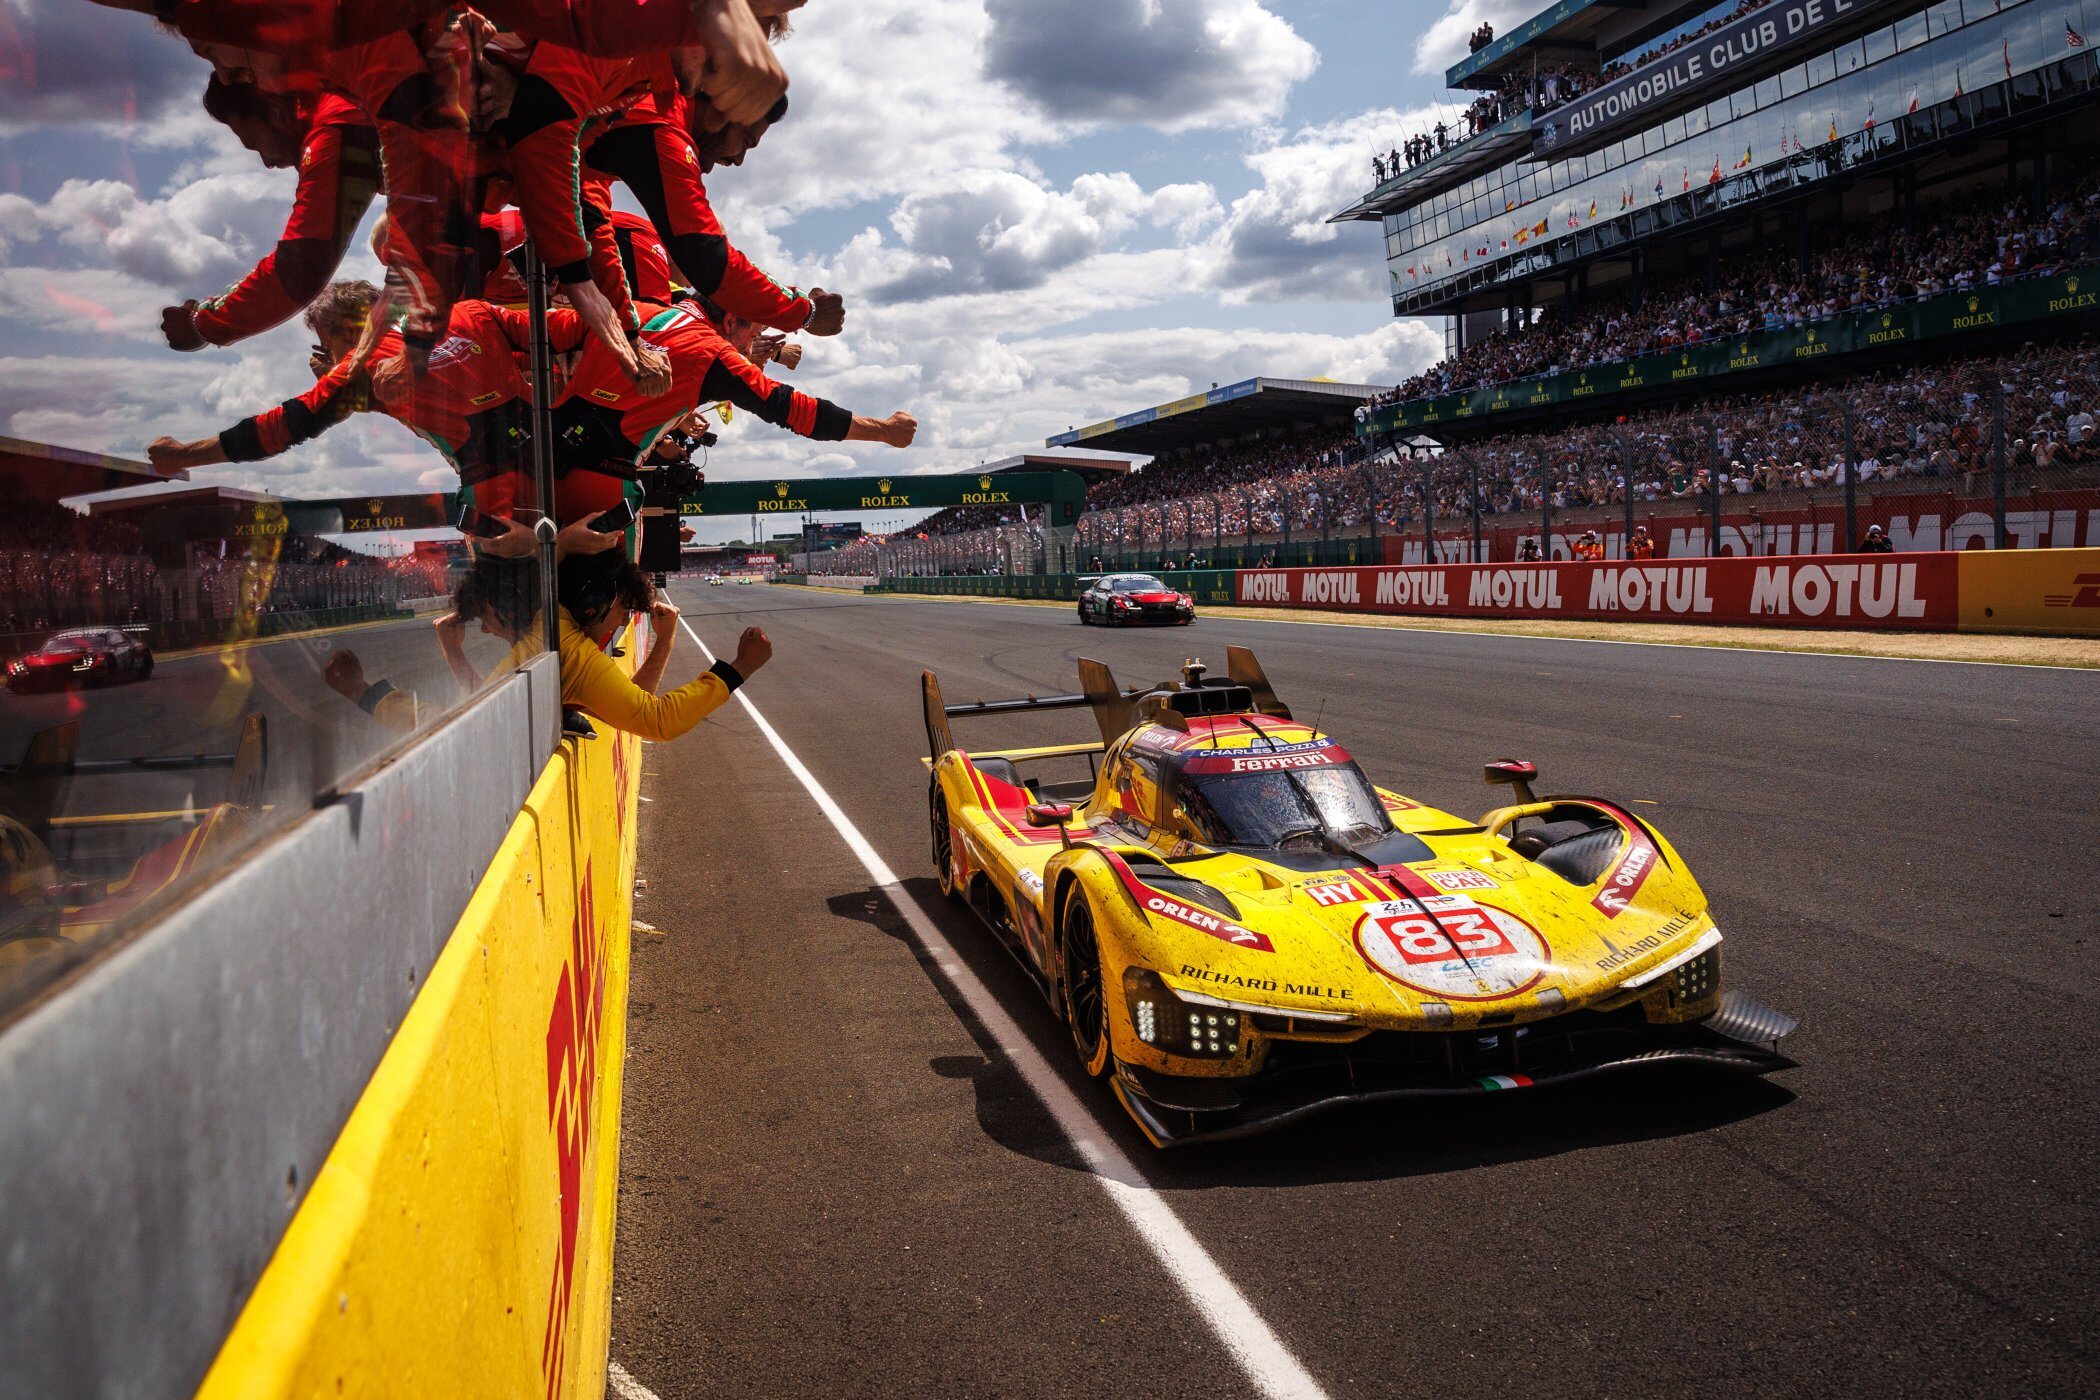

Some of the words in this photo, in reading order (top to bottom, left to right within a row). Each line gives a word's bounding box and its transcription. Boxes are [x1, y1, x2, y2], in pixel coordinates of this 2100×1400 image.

[1570, 55, 1703, 135] AUTOMOBILE
[1710, 20, 1777, 69] CLUB
[1787, 0, 1824, 35] DE
[2049, 293, 2097, 312] ROLEX
[1953, 312, 1994, 329] ROLEX
[1869, 328, 1905, 343] ROLEX
[1795, 343, 1828, 357] ROLEX
[1730, 355, 1759, 369] ROLEX
[1620, 376, 1644, 388] ROLEX
[1672, 366, 1698, 379] ROLEX
[1530, 394, 1550, 404] ROLEX
[1573, 385, 1594, 396] ROLEX
[758, 499, 808, 512] ROLEX
[861, 495, 910, 508] ROLEX
[962, 492, 1010, 504] ROLEX
[748, 555, 775, 564] MOTUL
[1242, 573, 1290, 601] MOTUL
[1301, 572, 1360, 604] MOTUL
[1375, 570, 1449, 606] MOTUL
[1468, 569, 1562, 609] MOTUL
[1588, 567, 1713, 613] MOTUL
[1750, 562, 1927, 618] MOTUL
[1199, 747, 1272, 757] CHARLES
[1275, 742, 1316, 753] POZZI
[1231, 751, 1333, 772] Ferrari
[1615, 846, 1653, 887] ORLEN
[1440, 877, 1495, 888] CAR
[1307, 882, 1358, 906] HY
[1147, 898, 1220, 931] ORLEN
[1390, 913, 1501, 956] 83
[1596, 935, 1661, 971] RICHARD
[1656, 909, 1696, 939] MILLE
[1180, 964, 1277, 991] RICHARD
[1285, 983, 1354, 1000] MILLE
